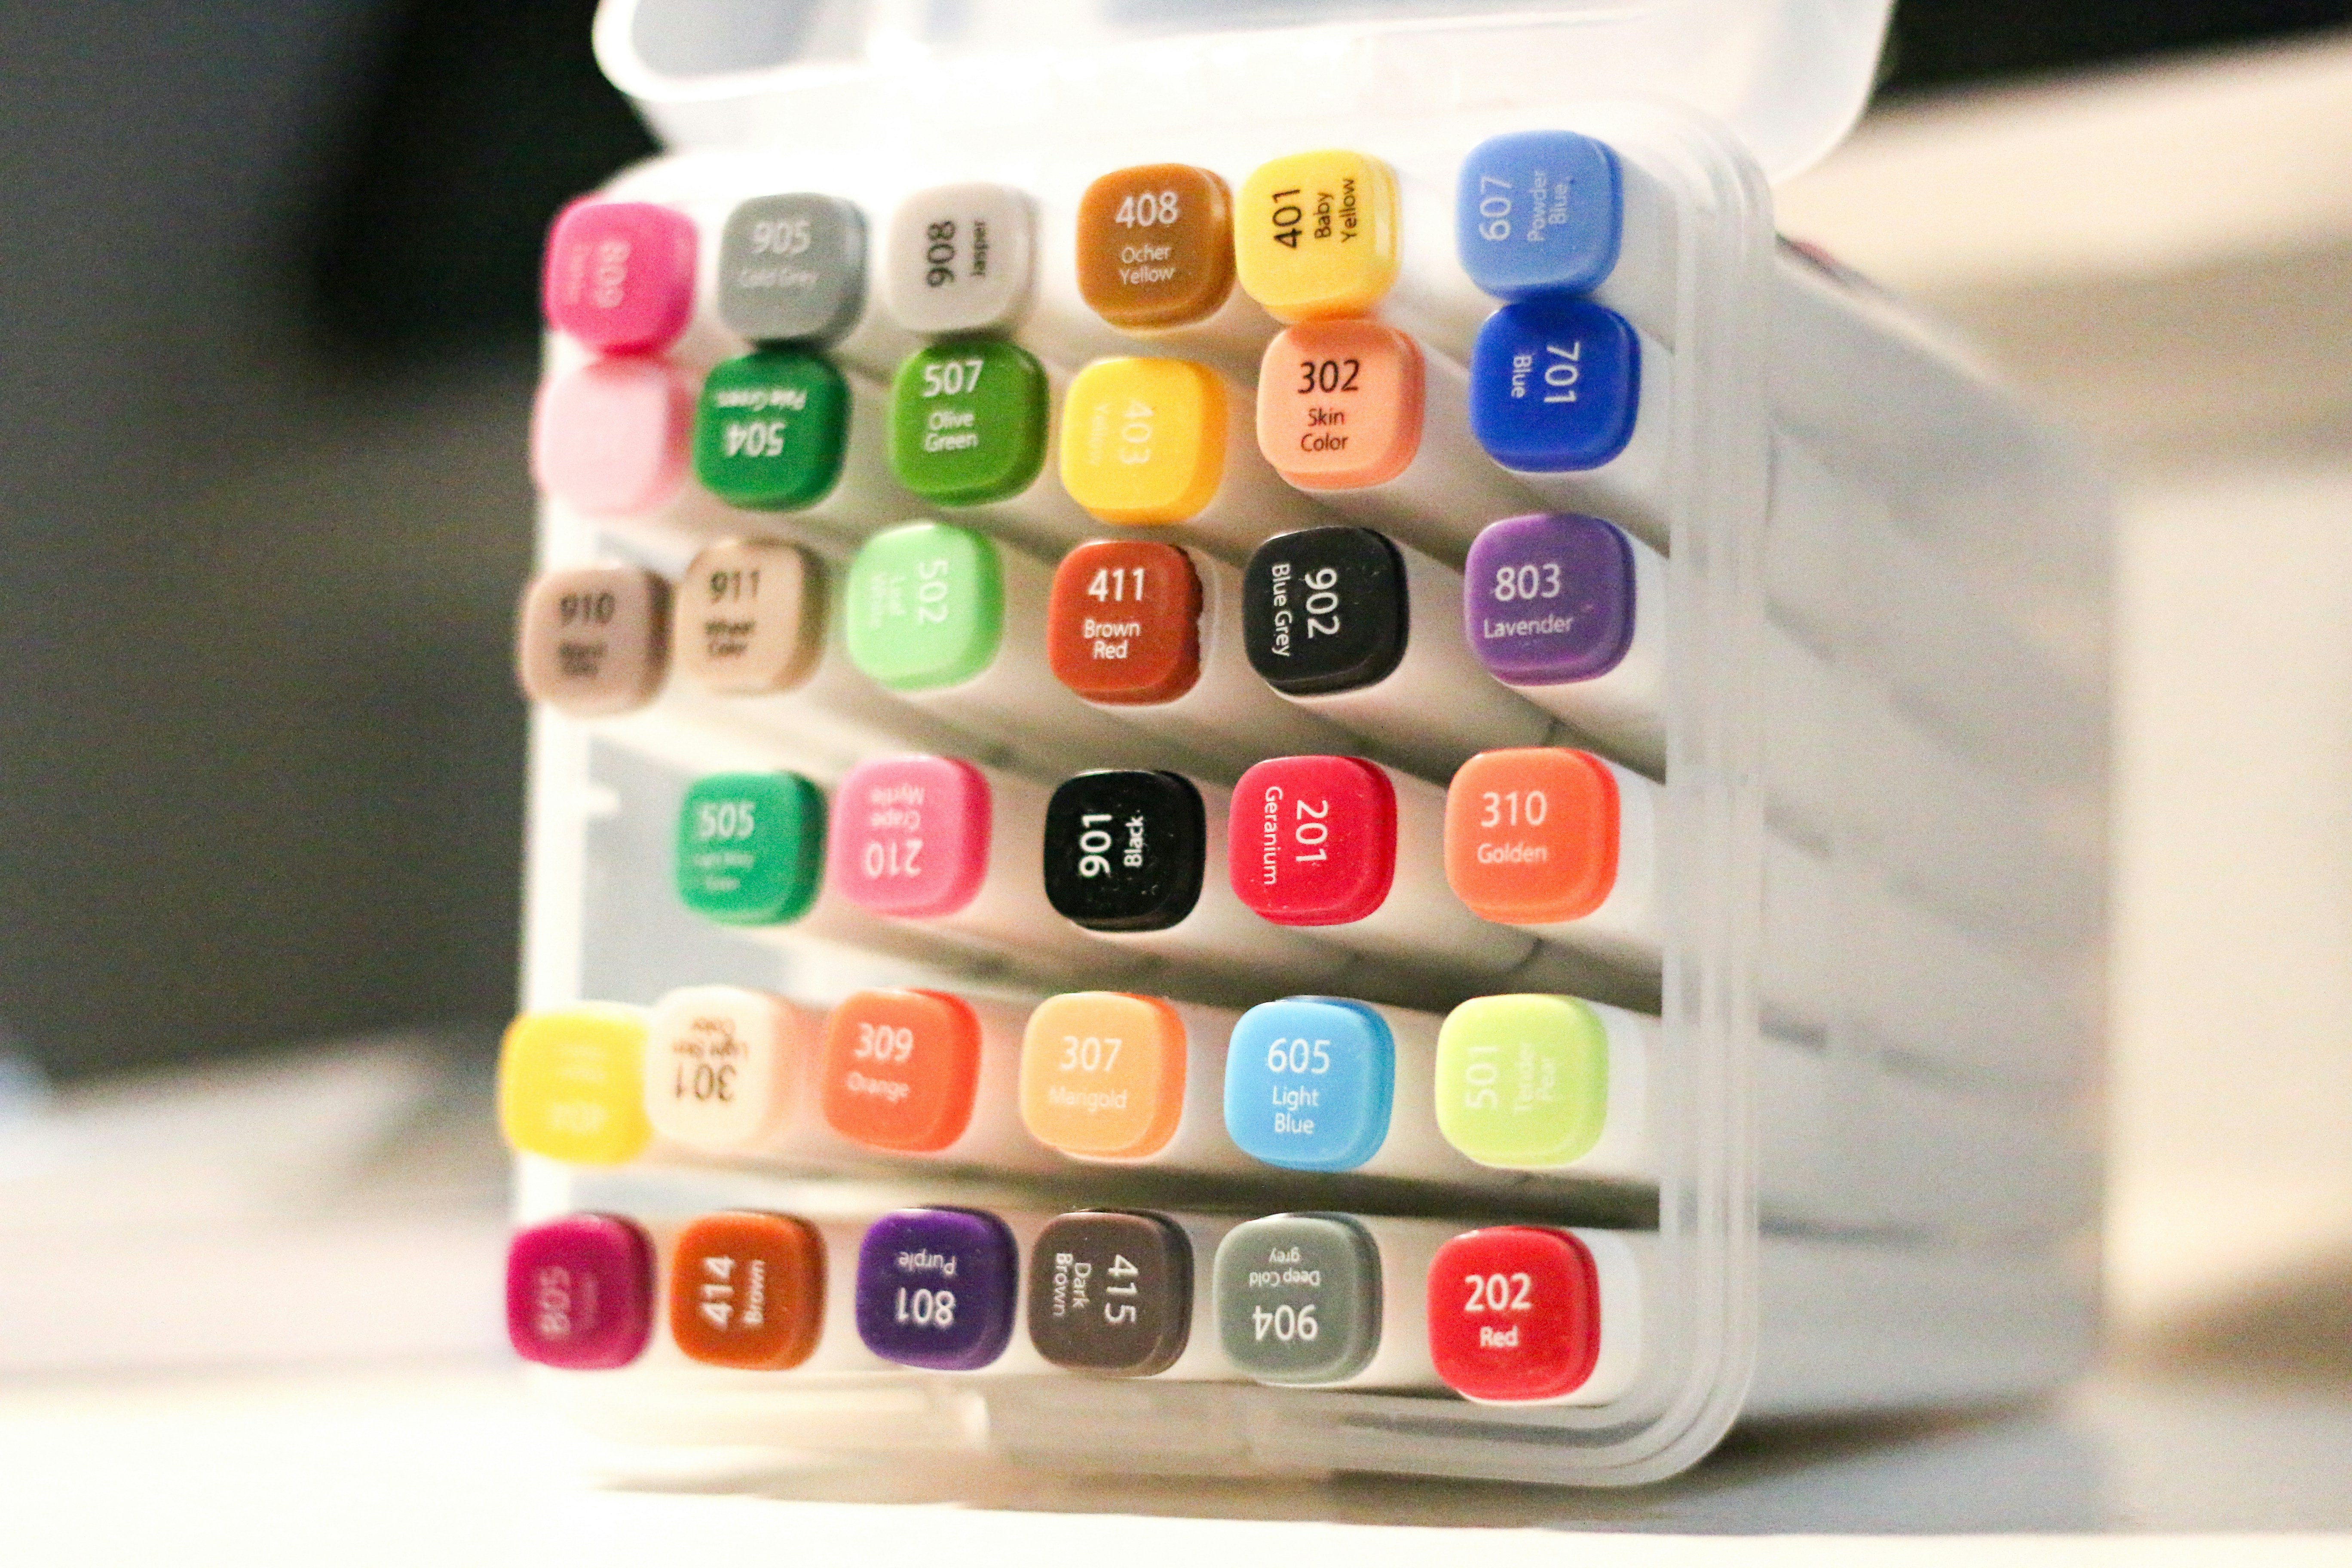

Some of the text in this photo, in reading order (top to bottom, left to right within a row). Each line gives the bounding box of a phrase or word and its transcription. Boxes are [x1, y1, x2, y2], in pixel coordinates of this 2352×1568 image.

[1115, 191, 1179, 229] 408
[1271, 187, 1302, 249] 401
[1314, 192, 1335, 239] Baby
[1340, 178, 1358, 243] Yellow
[1479, 177, 1513, 242] 607
[1527, 170, 1546, 242] Powder
[1548, 184, 1568, 224] Blue
[751, 221, 812, 256] 905
[926, 220, 956, 287] 908
[1121, 245, 1171, 263] Ocher
[1119, 265, 1176, 285] Yellow
[923, 360, 985, 398] 507
[1298, 358, 1360, 394] 302
[1511, 353, 1533, 399] Blue
[1544, 342, 1580, 404] 701
[928, 410, 974, 430] Olive
[1120, 400, 1154, 466] 403
[1308, 407, 1344, 427] Skin
[724, 421, 786, 456] 504
[924, 432, 979, 453] Green
[1301, 432, 1348, 453] Color
[710, 570, 761, 605] 911
[918, 559, 949, 625] 502
[1088, 567, 1145, 602] 411
[1495, 563, 1562, 602] 803
[560, 591, 616, 627] 910
[1271, 562, 1292, 657] Blue Grey
[1304, 567, 1341, 639] 902
[1083, 619, 1140, 639] Brown
[1483, 615, 1573, 639] Lavender
[1094, 640, 1128, 660] Red
[698, 802, 756, 840] 505
[871, 810, 921, 832] Crape
[1480, 790, 1547, 828] 310
[1079, 813, 1114, 879] 901
[1123, 815, 1145, 869] Black
[1263, 786, 1283, 885] Geranium
[1295, 799, 1330, 864] 201
[865, 838, 924, 879] 210
[1477, 842, 1548, 864] Golden
[854, 1023, 914, 1063] 309
[1059, 1035, 1124, 1072] 307
[1266, 1037, 1331, 1075] 605
[674, 1062, 737, 1102] 301
[848, 1072, 910, 1104] Orange
[1465, 1045, 1500, 1111] 501
[1513, 1042, 1536, 1114] Tender
[1535, 1057, 1558, 1101] Pear
[1048, 1085, 1128, 1113] Marigold
[1272, 1085, 1319, 1112] Light
[1274, 1112, 1315, 1135] Blue
[897, 1248, 957, 1276] Purple
[1268, 1247, 1300, 1264] grey
[701, 1255, 735, 1330] 414
[742, 1259, 766, 1327] Brown
[1053, 1252, 1074, 1317] Brown
[1072, 1262, 1093, 1308] Dark
[1105, 1253, 1139, 1326] 415
[1249, 1268, 1321, 1287] Deep Cold
[1464, 1272, 1532, 1312] 202
[895, 1288, 956, 1328] 801
[1253, 1304, 1318, 1342] 904
[1480, 1326, 1519, 1348] Red
